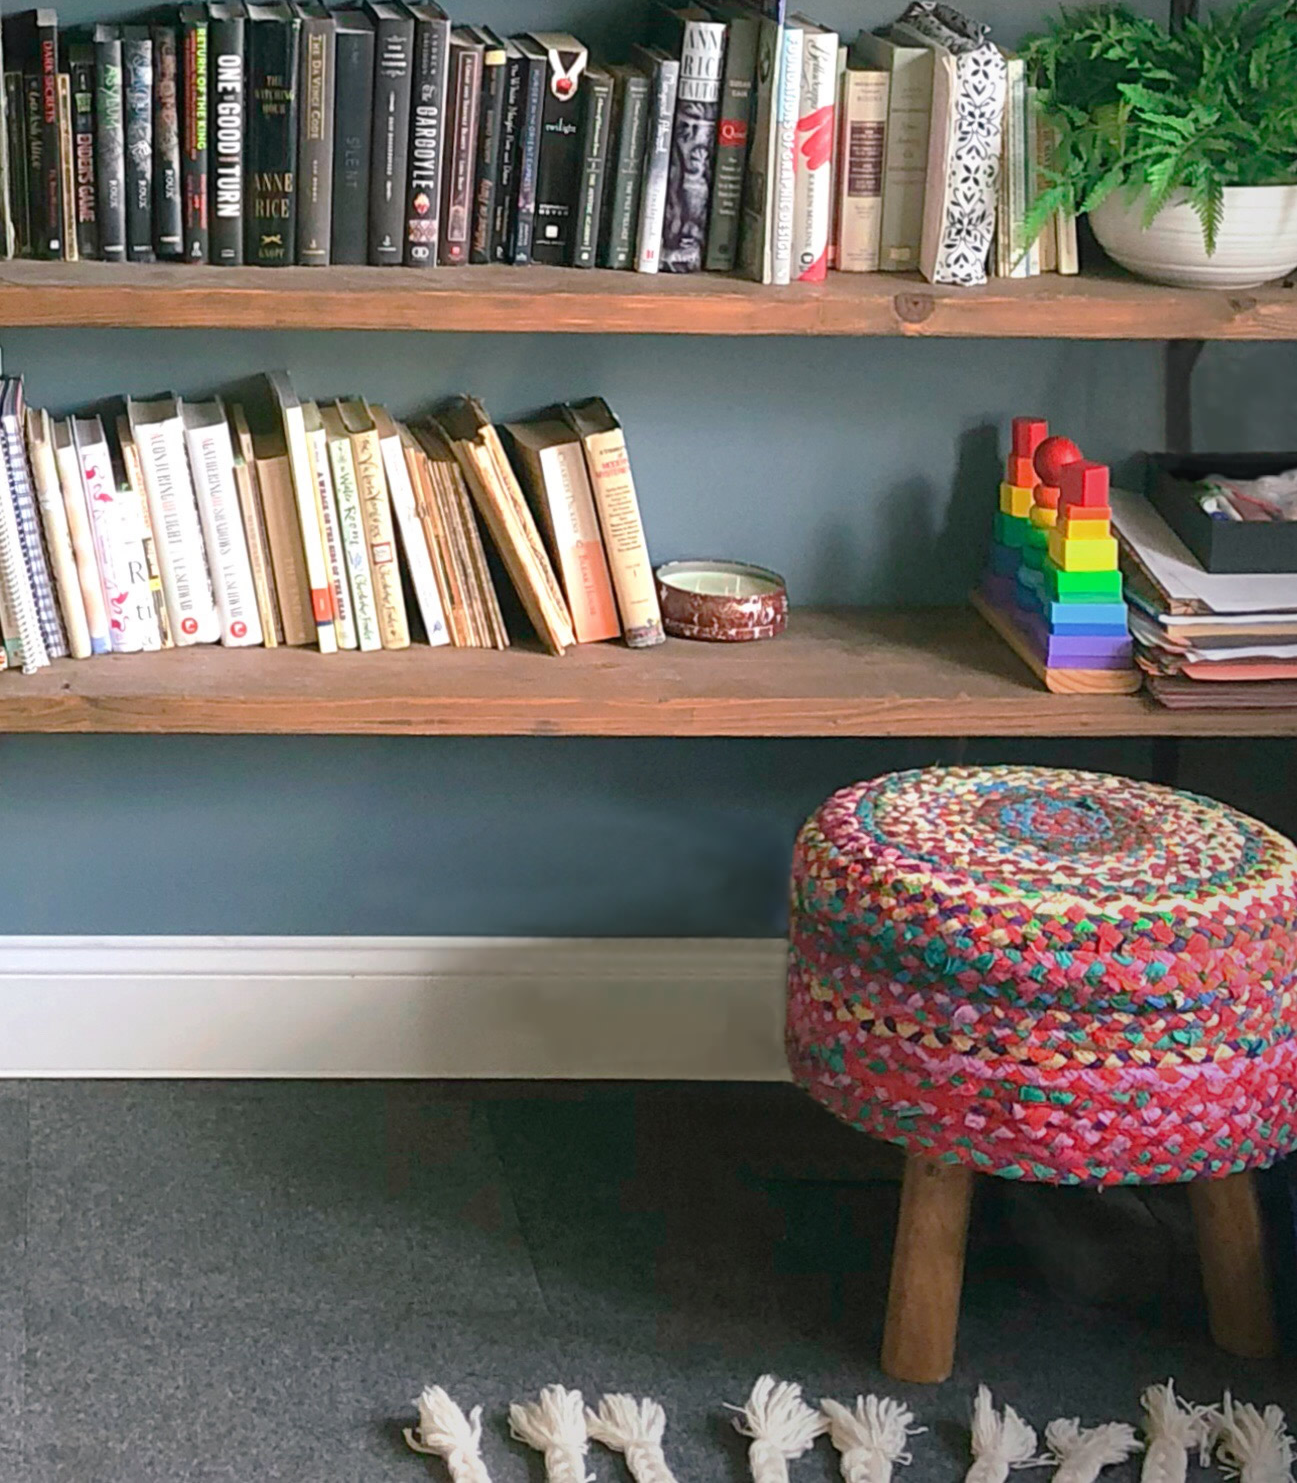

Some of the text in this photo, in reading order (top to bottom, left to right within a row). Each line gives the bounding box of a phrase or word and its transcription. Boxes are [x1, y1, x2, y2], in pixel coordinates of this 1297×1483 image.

[197, 28, 207, 150] RETURN OF THE KING
[311, 34, 322, 139] THE DA VINCI CODE
[77, 133, 95, 223] ENDER'S GAME
[217, 54, 241, 218] ONE GOOD TURN
[412, 105, 438, 189] GARGOYLE
[776, 35, 799, 260] FOUNDATIONS OF GRAPHIC DESIGN
[109, 179, 118, 208] ROUX
[138, 179, 148, 209] ROUX
[164, 169, 176, 199] ROUX
[255, 173, 293, 193] ANNE
[255, 198, 290, 218] RICE
